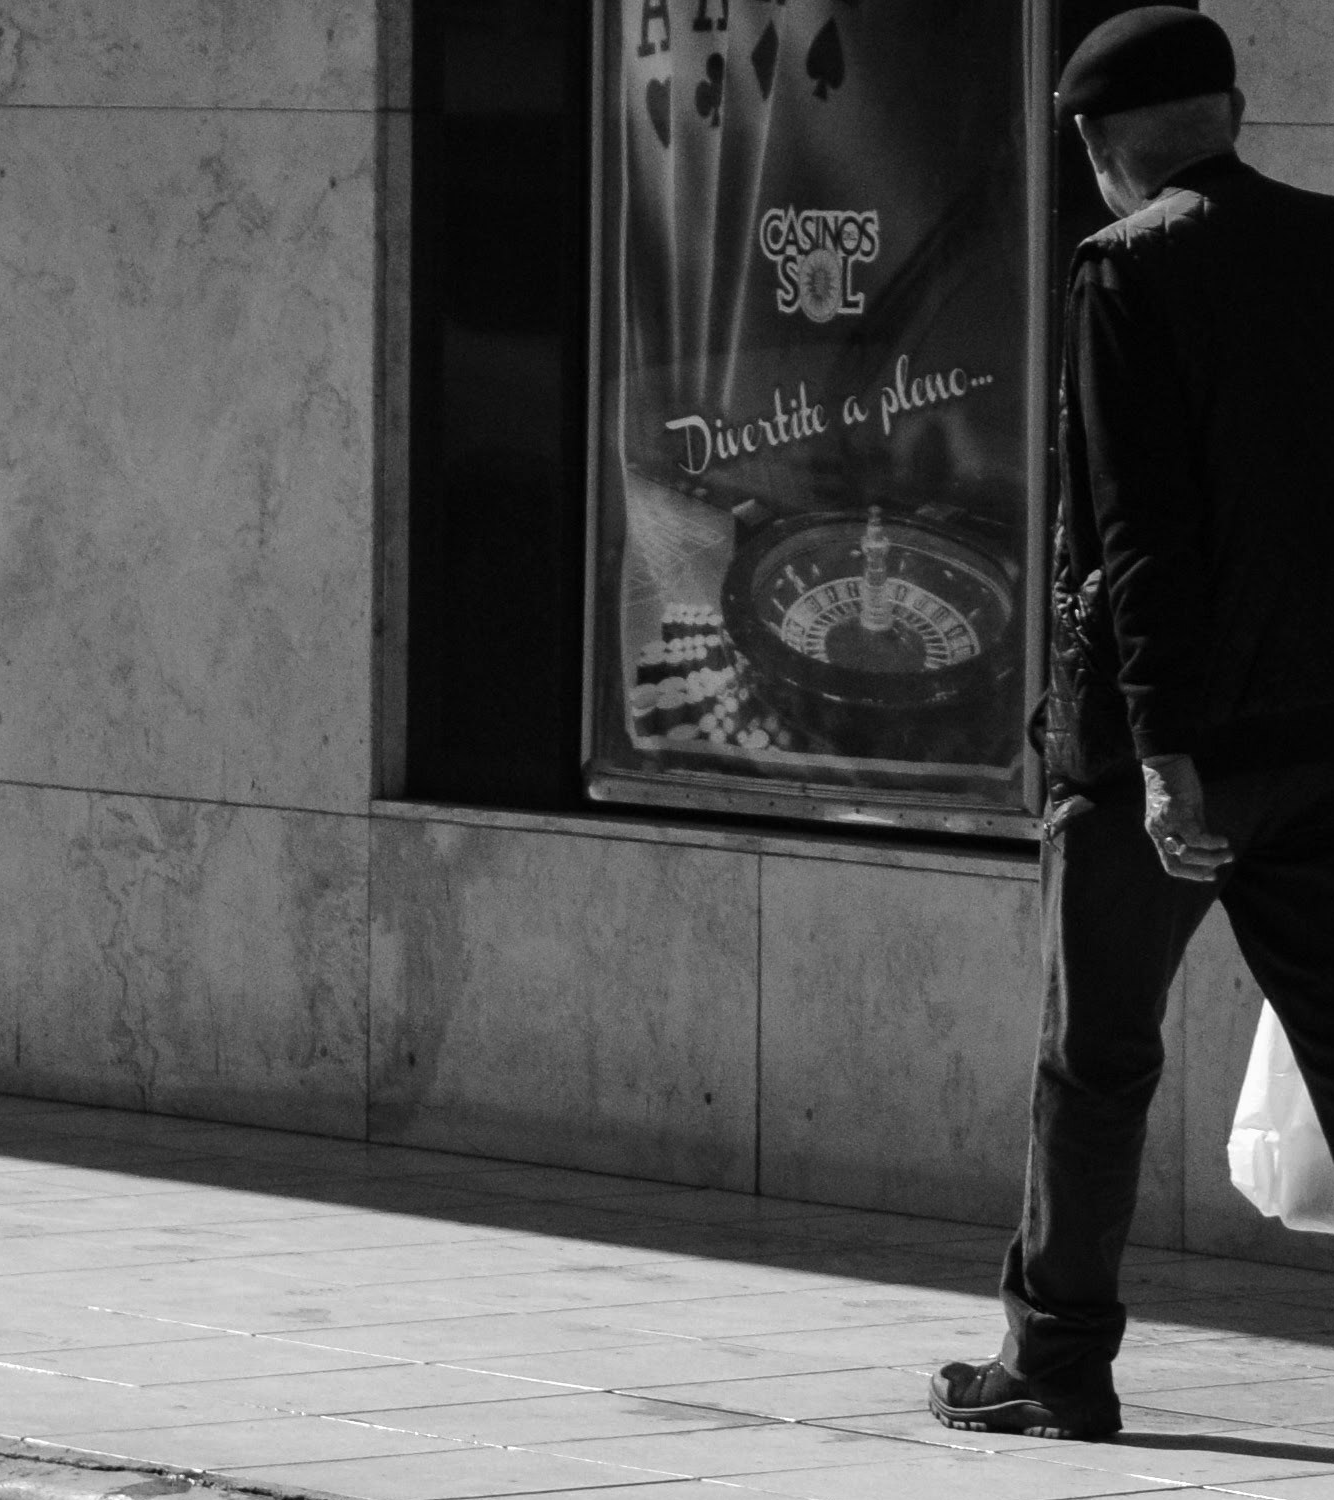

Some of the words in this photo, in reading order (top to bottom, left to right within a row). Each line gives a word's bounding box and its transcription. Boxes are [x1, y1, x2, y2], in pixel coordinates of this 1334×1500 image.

[761, 206, 878, 260] CASINOS
[665, 381, 830, 475] Divertite
[842, 395, 869, 425] a
